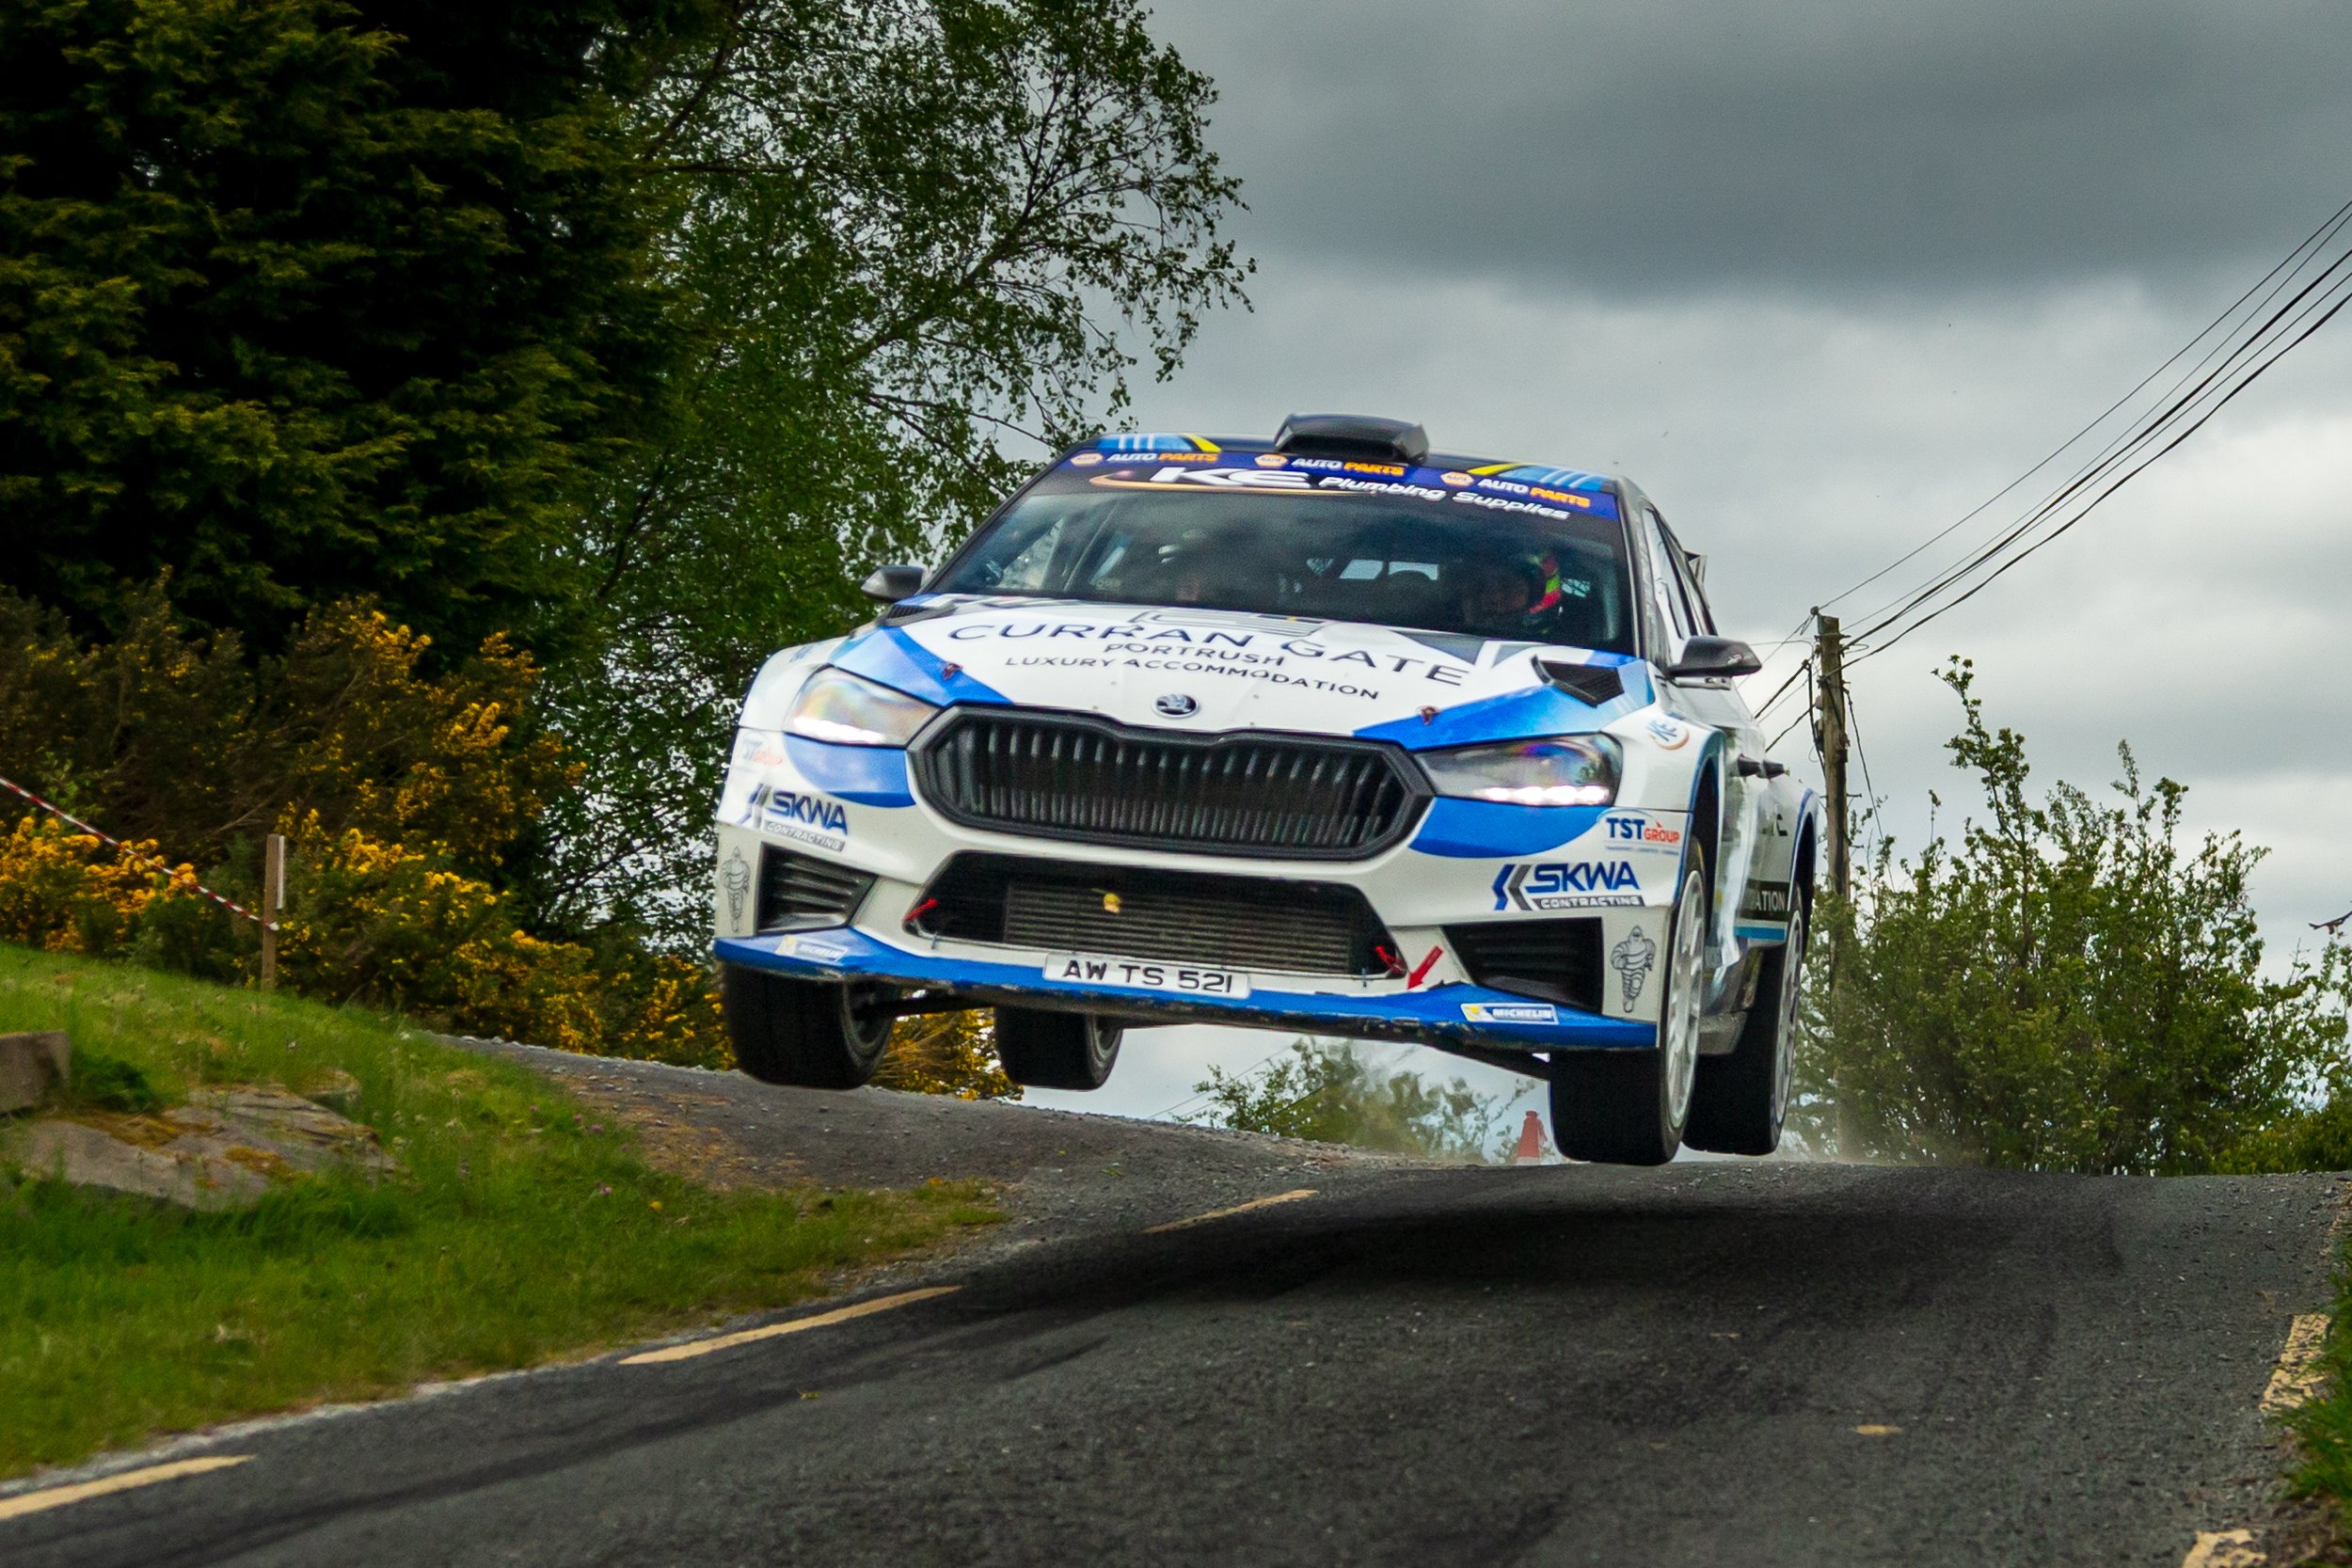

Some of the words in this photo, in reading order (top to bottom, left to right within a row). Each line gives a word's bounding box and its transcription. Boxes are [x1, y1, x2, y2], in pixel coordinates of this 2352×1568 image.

[1106, 453, 1158, 462] AUTO
[1158, 453, 1218, 463] PARTS
[1291, 458, 1343, 469] AUTO
[1343, 462, 1406, 477] PARTS
[1150, 467, 1311, 488] KE
[1318, 476, 1447, 501] Plumbing
[1452, 492, 1570, 520] Supplies
[1477, 479, 1530, 495] AUTO
[1530, 487, 1591, 509] PARTS
[948, 624, 1254, 647] CURRAN
[1280, 639, 1470, 686] GATE
[1103, 643, 1285, 666] PORTRUSH
[1004, 657, 1116, 667] LUXURY
[1123, 659, 1379, 700] ACCOMMODATION
[767, 790, 848, 836] SKWA
[767, 822, 841, 849] CONTRACTING
[1606, 817, 1645, 839] TST
[1644, 828, 1680, 843] GROUP
[1524, 861, 1641, 894] SKWA
[1540, 896, 1641, 909] CONTRACTING
[1062, 959, 1107, 981] AW
[1119, 964, 1164, 986] TS
[1178, 970, 1232, 993] 521
